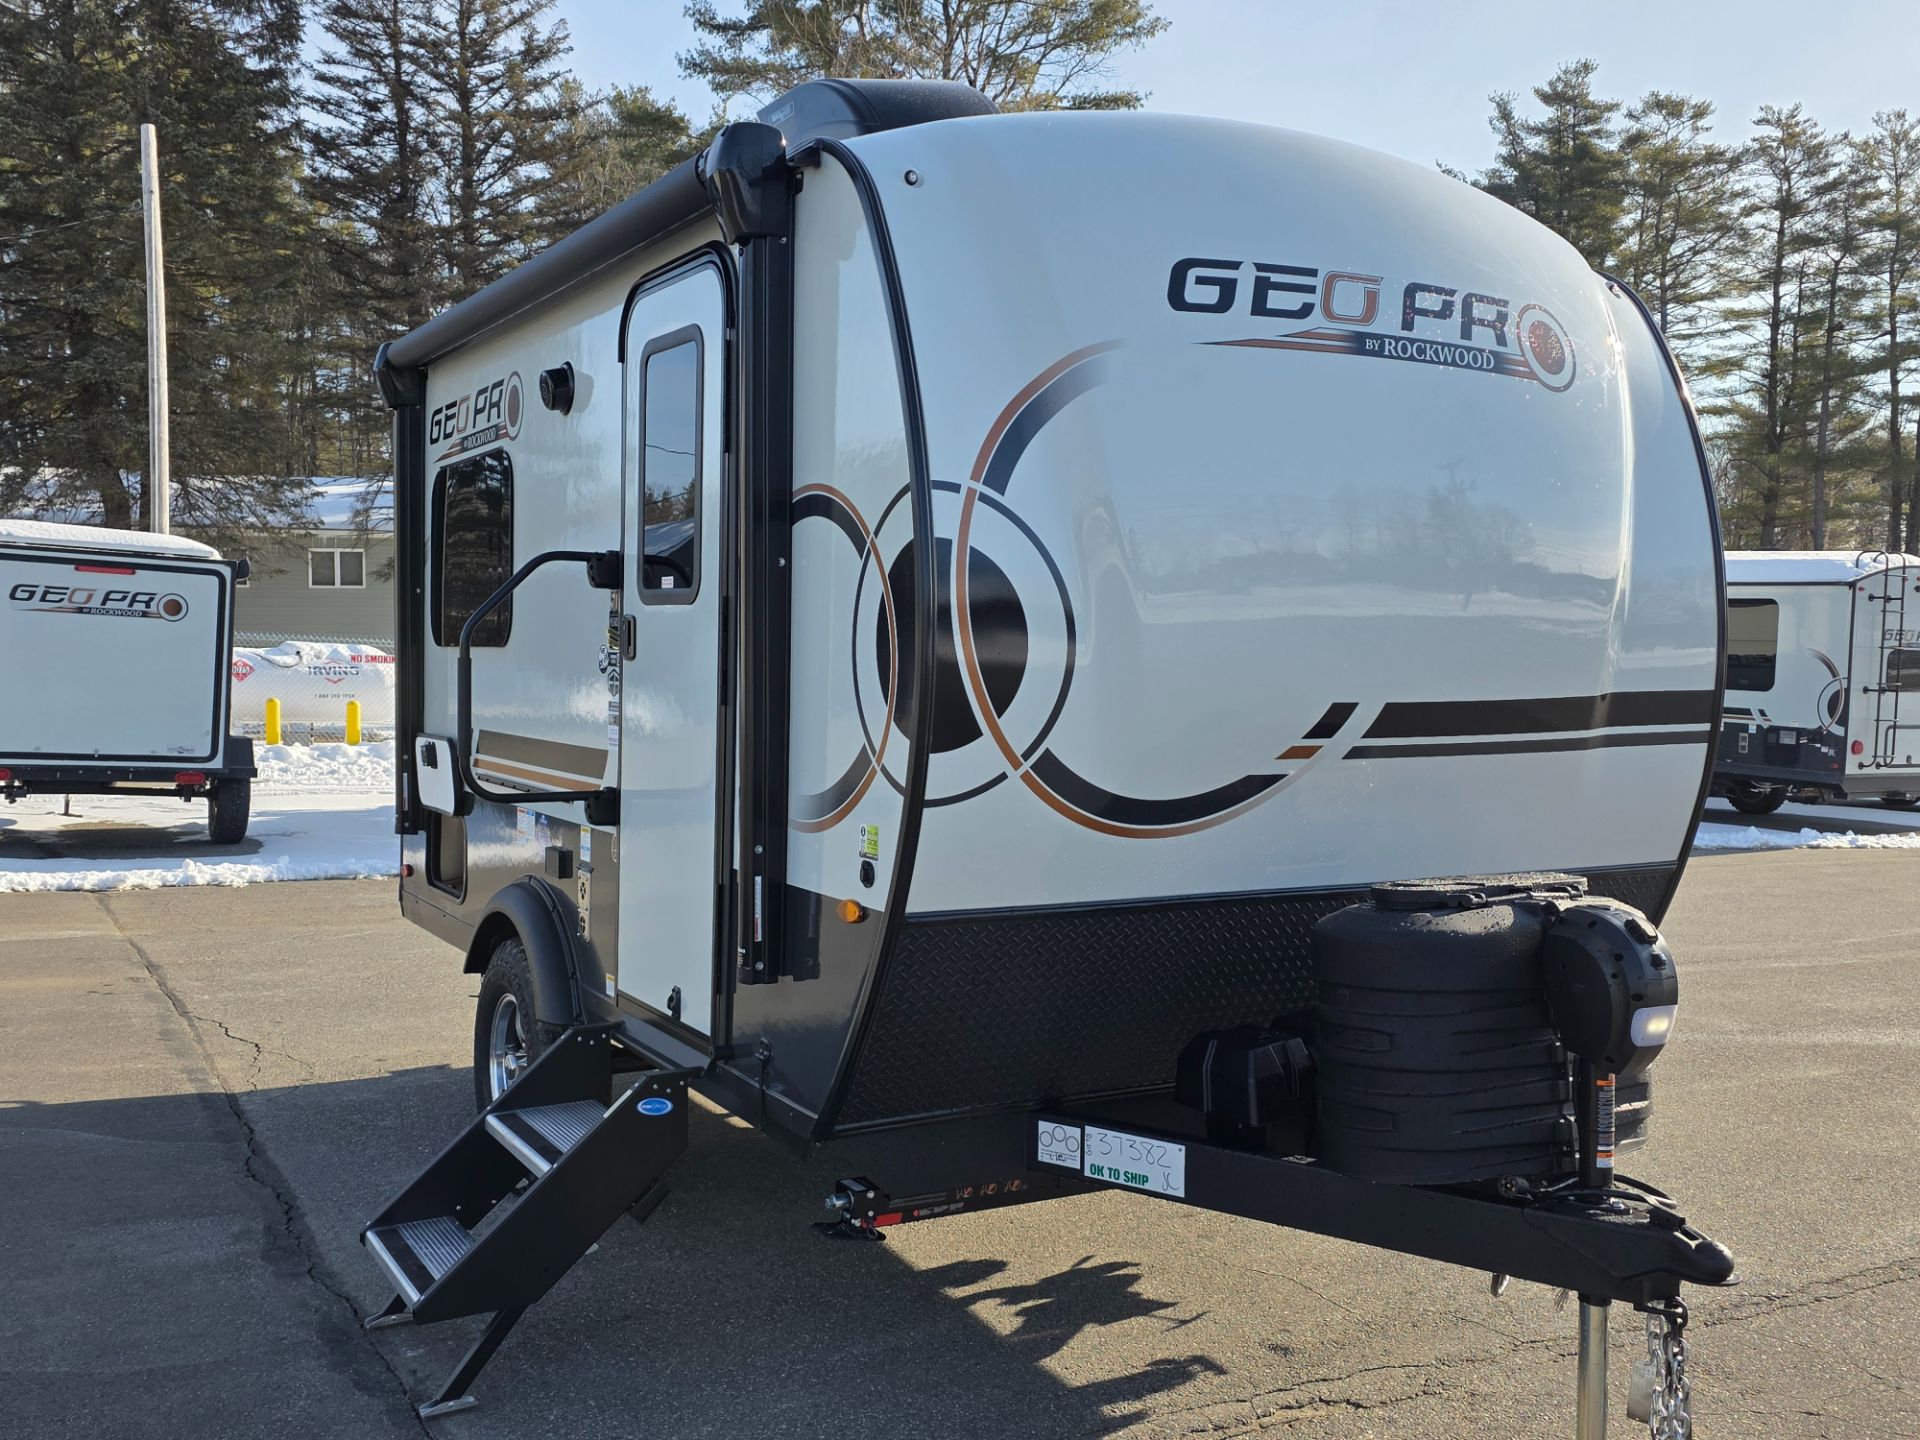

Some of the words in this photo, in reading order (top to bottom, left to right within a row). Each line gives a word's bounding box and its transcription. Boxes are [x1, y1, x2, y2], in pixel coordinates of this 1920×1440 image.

[1167, 257, 1384, 326] GEO
[1401, 282, 1577, 393] PRO
[1365, 338, 1381, 351] BY
[1383, 337, 1495, 370] ROCKWOOD
[430, 393, 472, 446] GEO
[472, 370, 525, 441] PRO
[467, 426, 497, 449] ROCKWOOD
[9, 583, 98, 605] GEO
[100, 589, 189, 622] PRO
[90, 607, 143, 617] ROCKWOOD
[307, 665, 361, 676] IRVING
[351, 654, 363, 664] NO
[1097, 1132, 1172, 1169] 37382
[1089, 1163, 1105, 1178] OK
[1107, 1166, 1121, 1181] TO
[1123, 1170, 1149, 1186] SHIP
